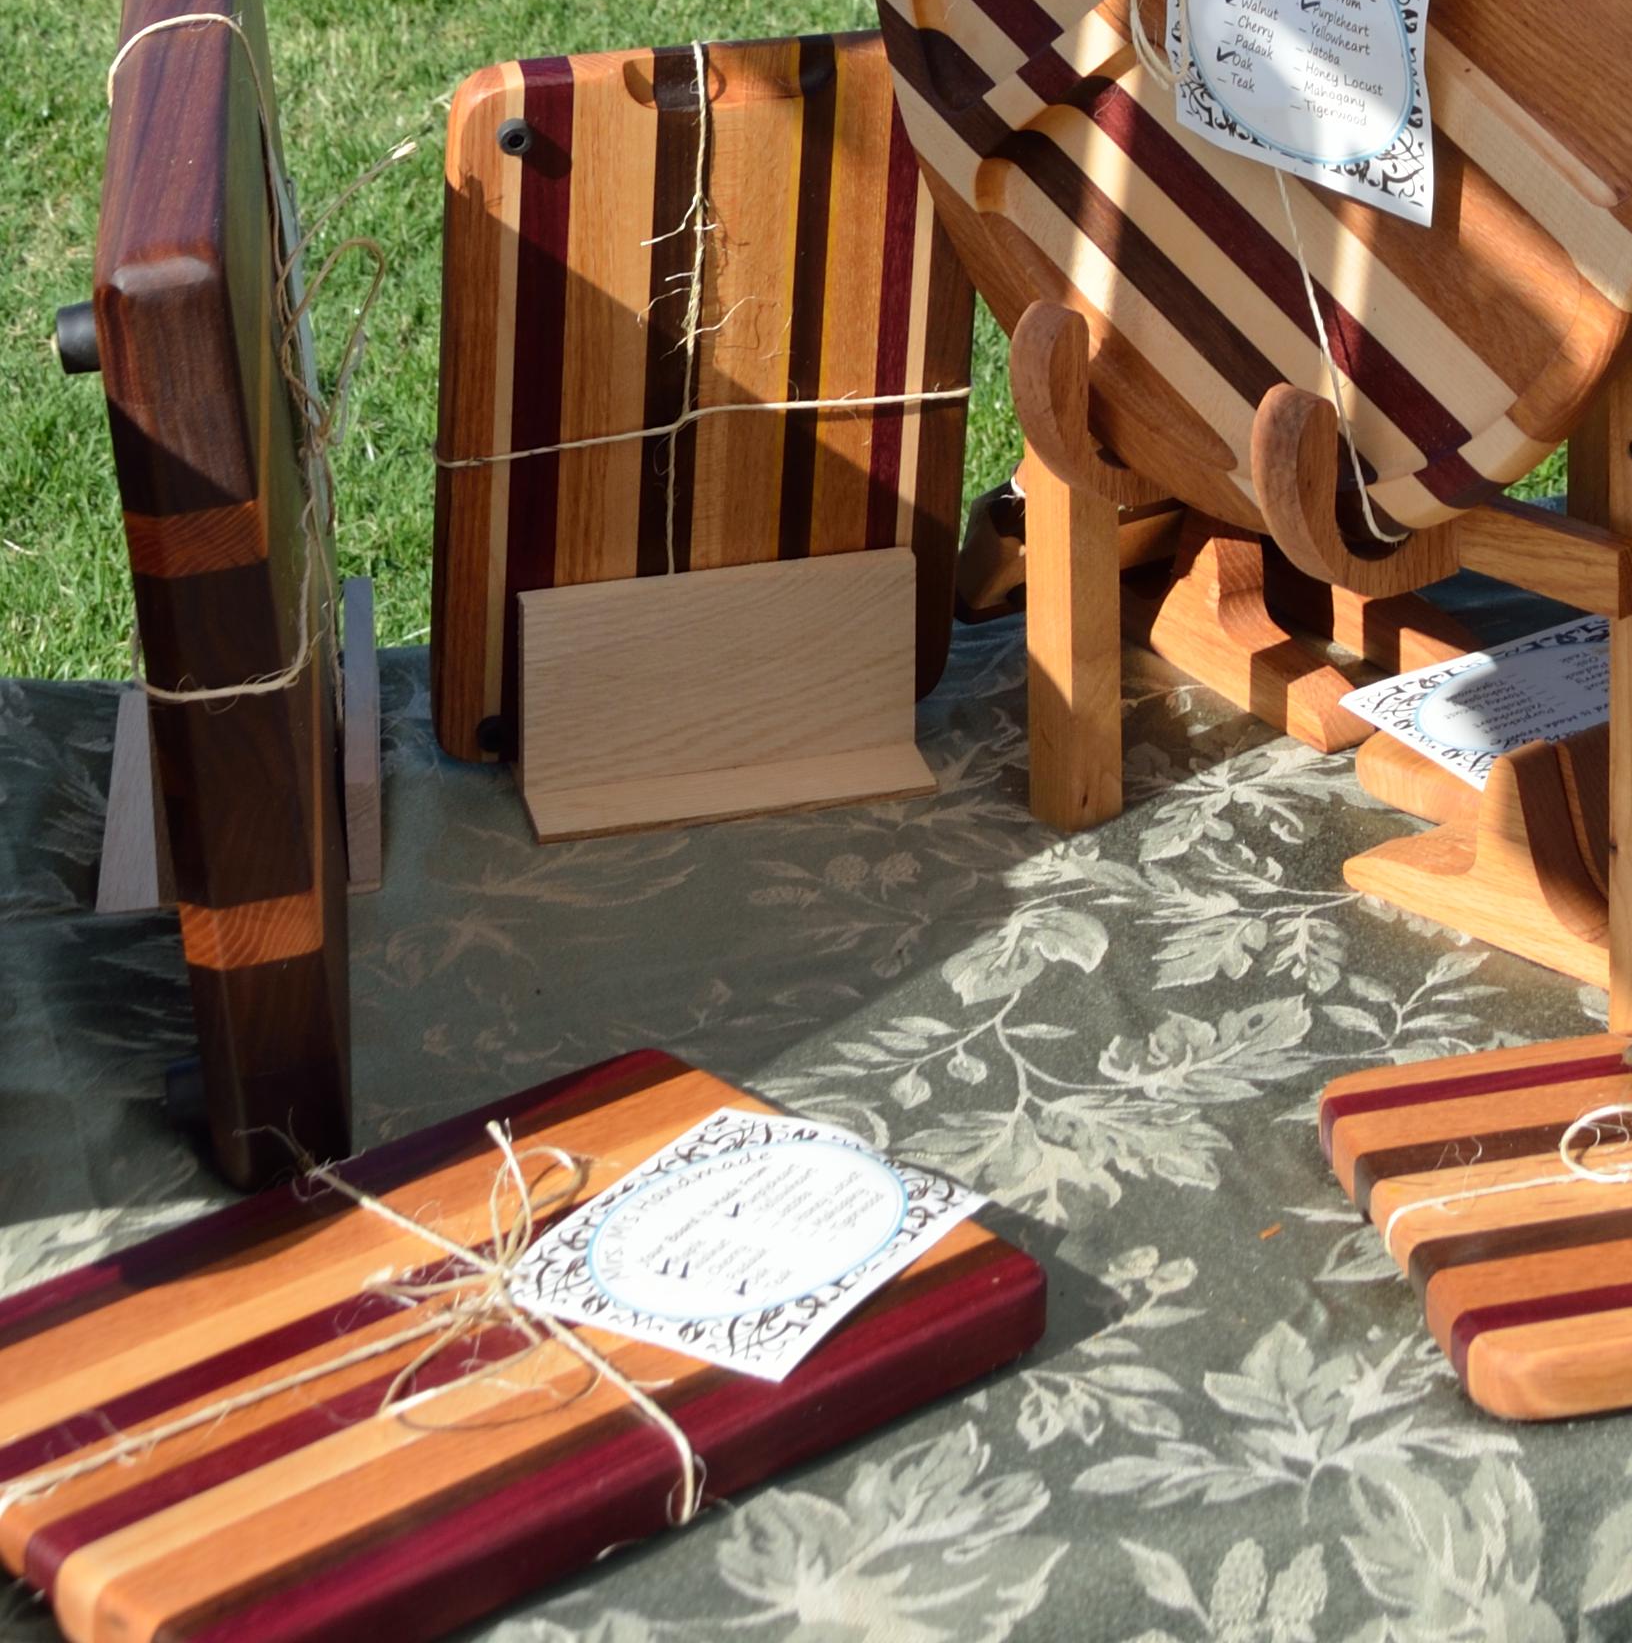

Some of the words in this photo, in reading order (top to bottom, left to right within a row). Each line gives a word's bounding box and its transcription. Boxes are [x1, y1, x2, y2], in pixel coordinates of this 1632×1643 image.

[1237, 16, 1273, 42] Cherry
[1312, 4, 1370, 37] Purpleheart
[1235, 35, 1273, 60] Padauk
[1311, 22, 1370, 55] Yellowheart
[1232, 54, 1253, 72] Oak
[1307, 43, 1340, 66] Jatoba
[1230, 72, 1256, 94] Teak
[1306, 61, 1339, 85] Honey
[1344, 74, 1383, 96] Locust
